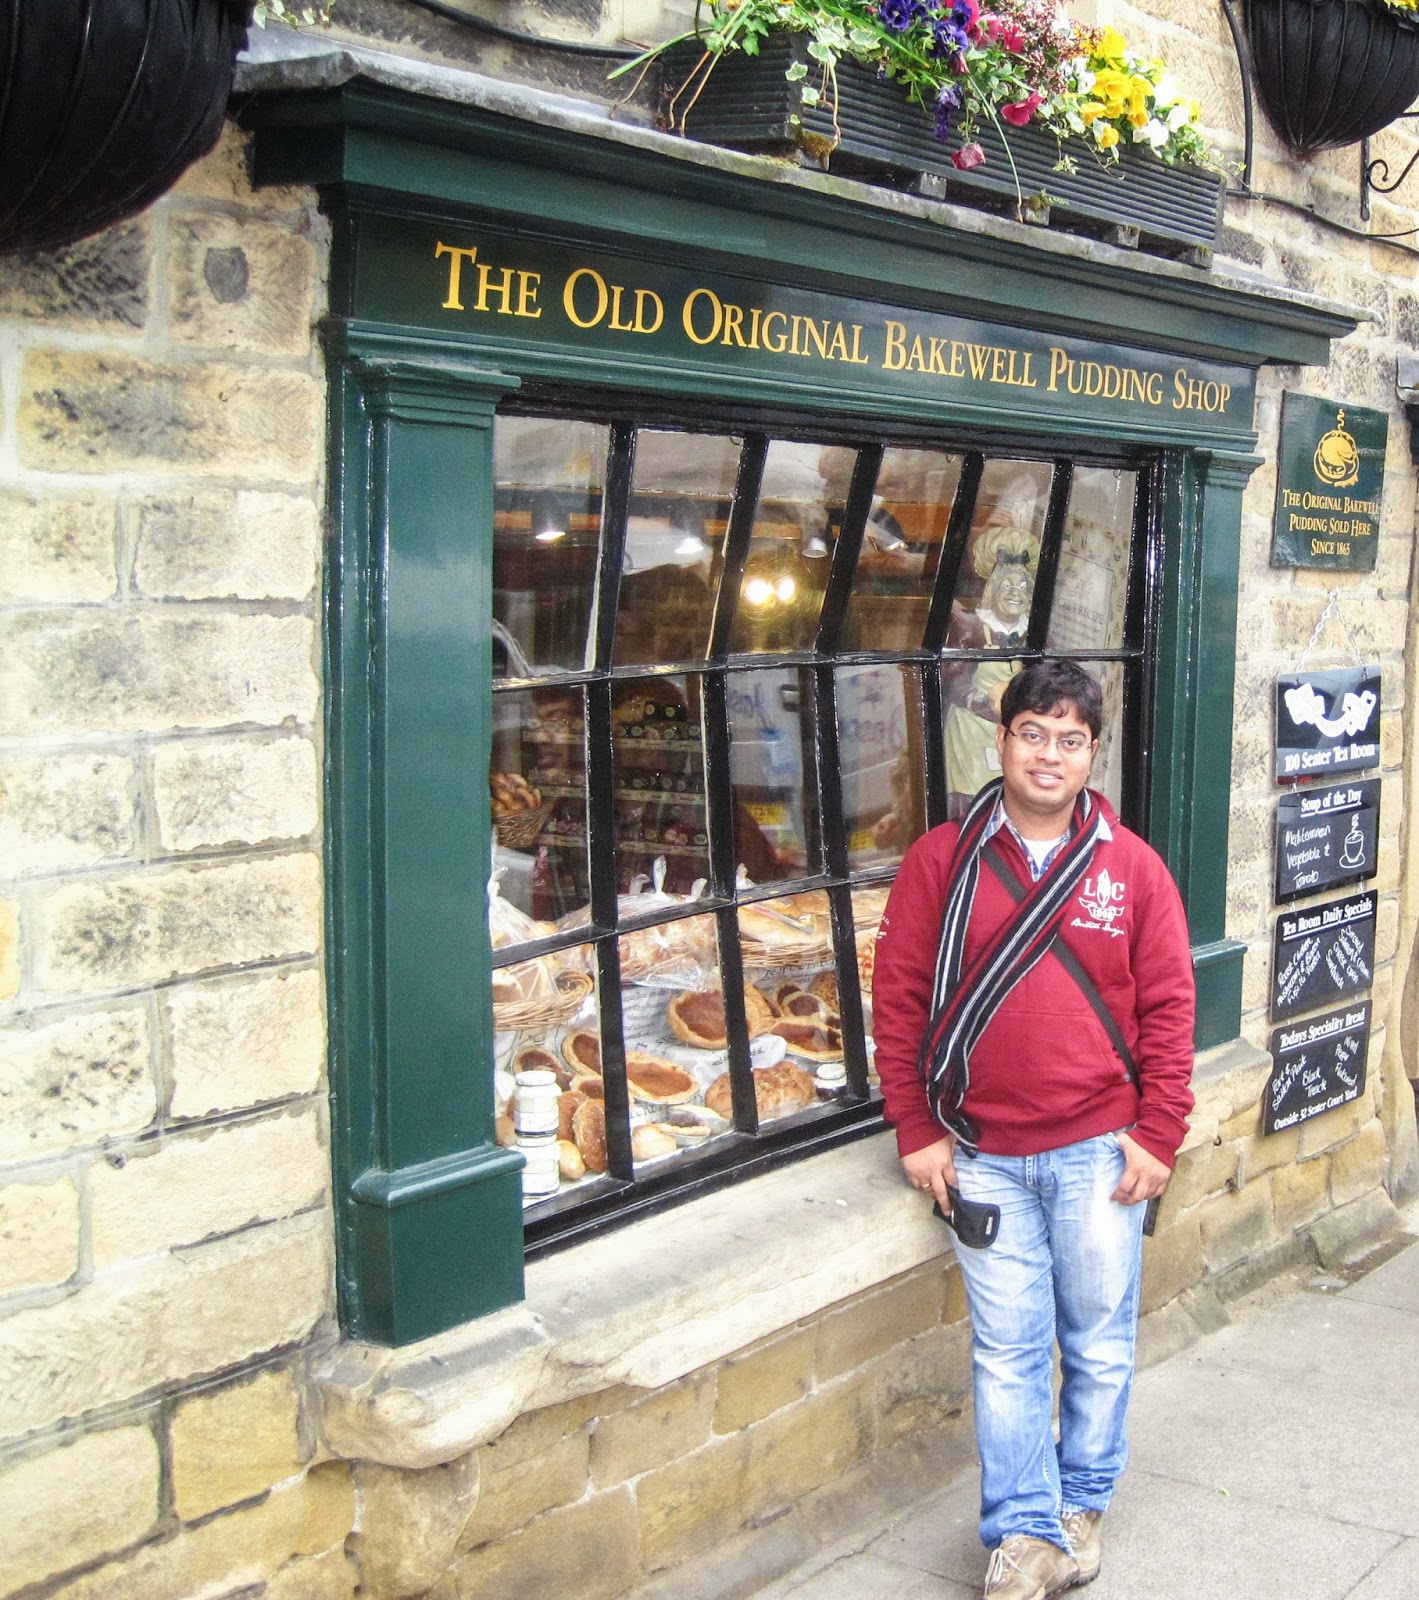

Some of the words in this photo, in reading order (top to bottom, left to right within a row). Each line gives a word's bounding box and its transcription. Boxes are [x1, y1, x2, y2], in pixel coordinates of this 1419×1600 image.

[434, 240, 542, 319] THE
[563, 267, 664, 334] OLD
[682, 287, 870, 365] ORIGINAL
[882, 319, 1037, 389] BAKEWELL
[1046, 347, 1163, 405] PUDDING
[1172, 368, 1231, 413] SHOP
[1282, 489, 1301, 508] THE
[1302, 491, 1342, 511] ORIGINAL
[1343, 497, 1380, 515] BAKEWELL
[1289, 513, 1328, 532] PUDDING
[1329, 517, 1350, 535] SOLD
[1351, 519, 1372, 536] HERE
[1311, 538, 1335, 556] SINCE
[1336, 542, 1351, 556] 1865
[1284, 753, 1300, 772] 100
[1302, 750, 1332, 769] Seater
[1333, 745, 1349, 763] Tea
[1350, 743, 1376, 760] Room
[1300, 797, 1321, 814] Soup
[1322, 792, 1332, 808] of
[1333, 790, 1347, 805] the
[1347, 788, 1363, 806] Day
[1286, 846, 1321, 871] Vegetable
[1083, 878, 1096, 897] L
[1111, 881, 1126, 901] C
[1282, 920, 1297, 937] Tea
[1298, 915, 1321, 932] Room
[1322, 906, 1343, 925] Daily
[1344, 898, 1373, 920] Specials
[1279, 1026, 1308, 1048] Todays
[1308, 1017, 1345, 1040] Speciality
[1345, 1007, 1366, 1027] Bread
[1273, 1111, 1299, 1131] Outside
[1299, 1108, 1308, 1122] 32
[1307, 1099, 1327, 1118] Seater
[1326, 1092, 1345, 1110] Court
[1344, 1085, 1358, 1101] Yard
